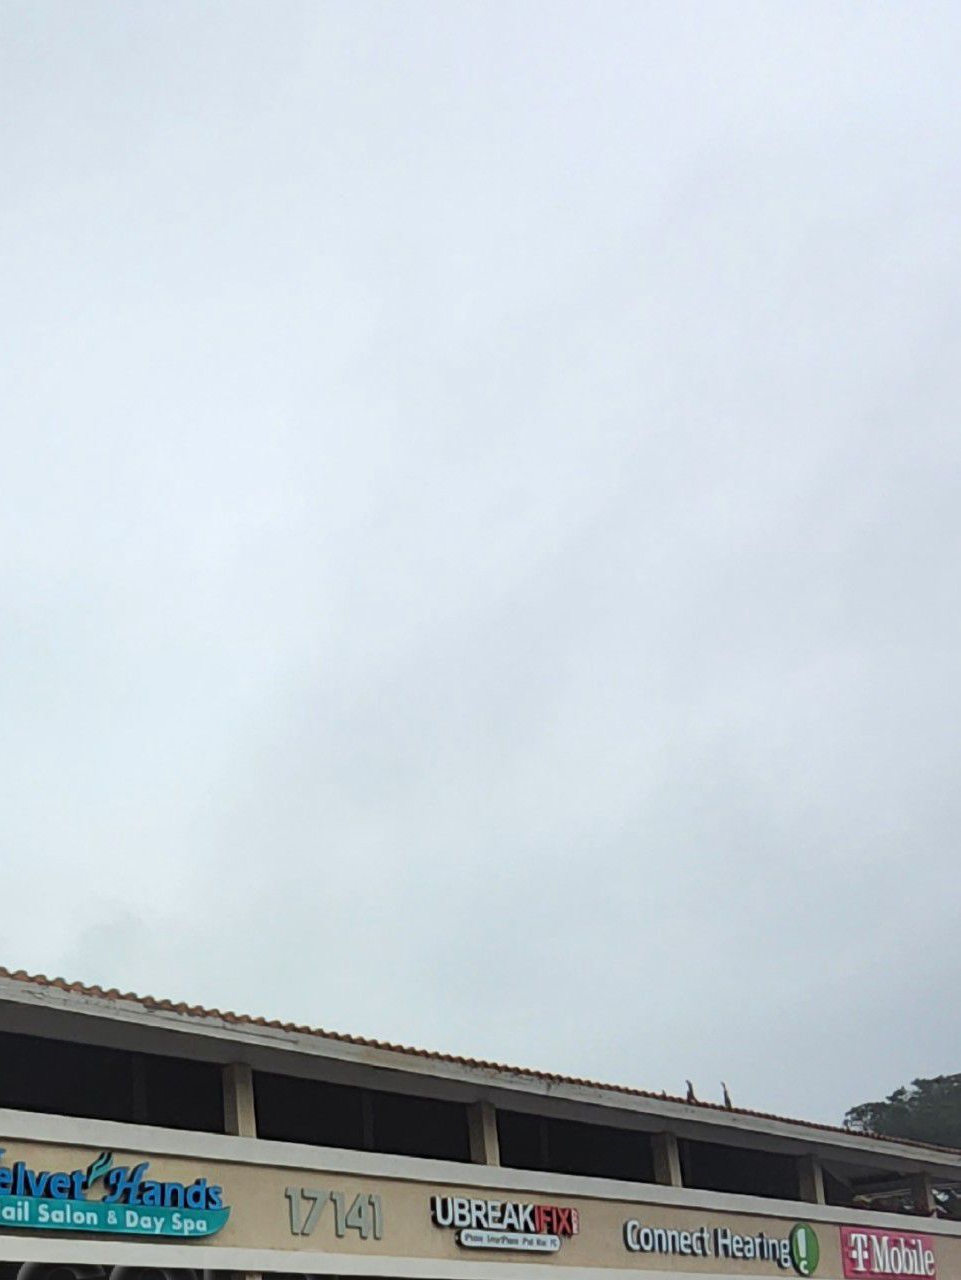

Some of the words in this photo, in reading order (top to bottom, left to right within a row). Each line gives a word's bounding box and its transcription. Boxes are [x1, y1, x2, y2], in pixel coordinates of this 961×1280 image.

[104, 1162, 224, 1208] Hands
[37, 1203, 99, 1226] Salon
[106, 1210, 119, 1225] &
[125, 1209, 165, 1235] Day
[171, 1212, 208, 1235] Spa
[285, 1187, 384, 1240] 17141
[624, 1220, 712, 1255] Connect
[717, 1227, 791, 1268] Hearing
